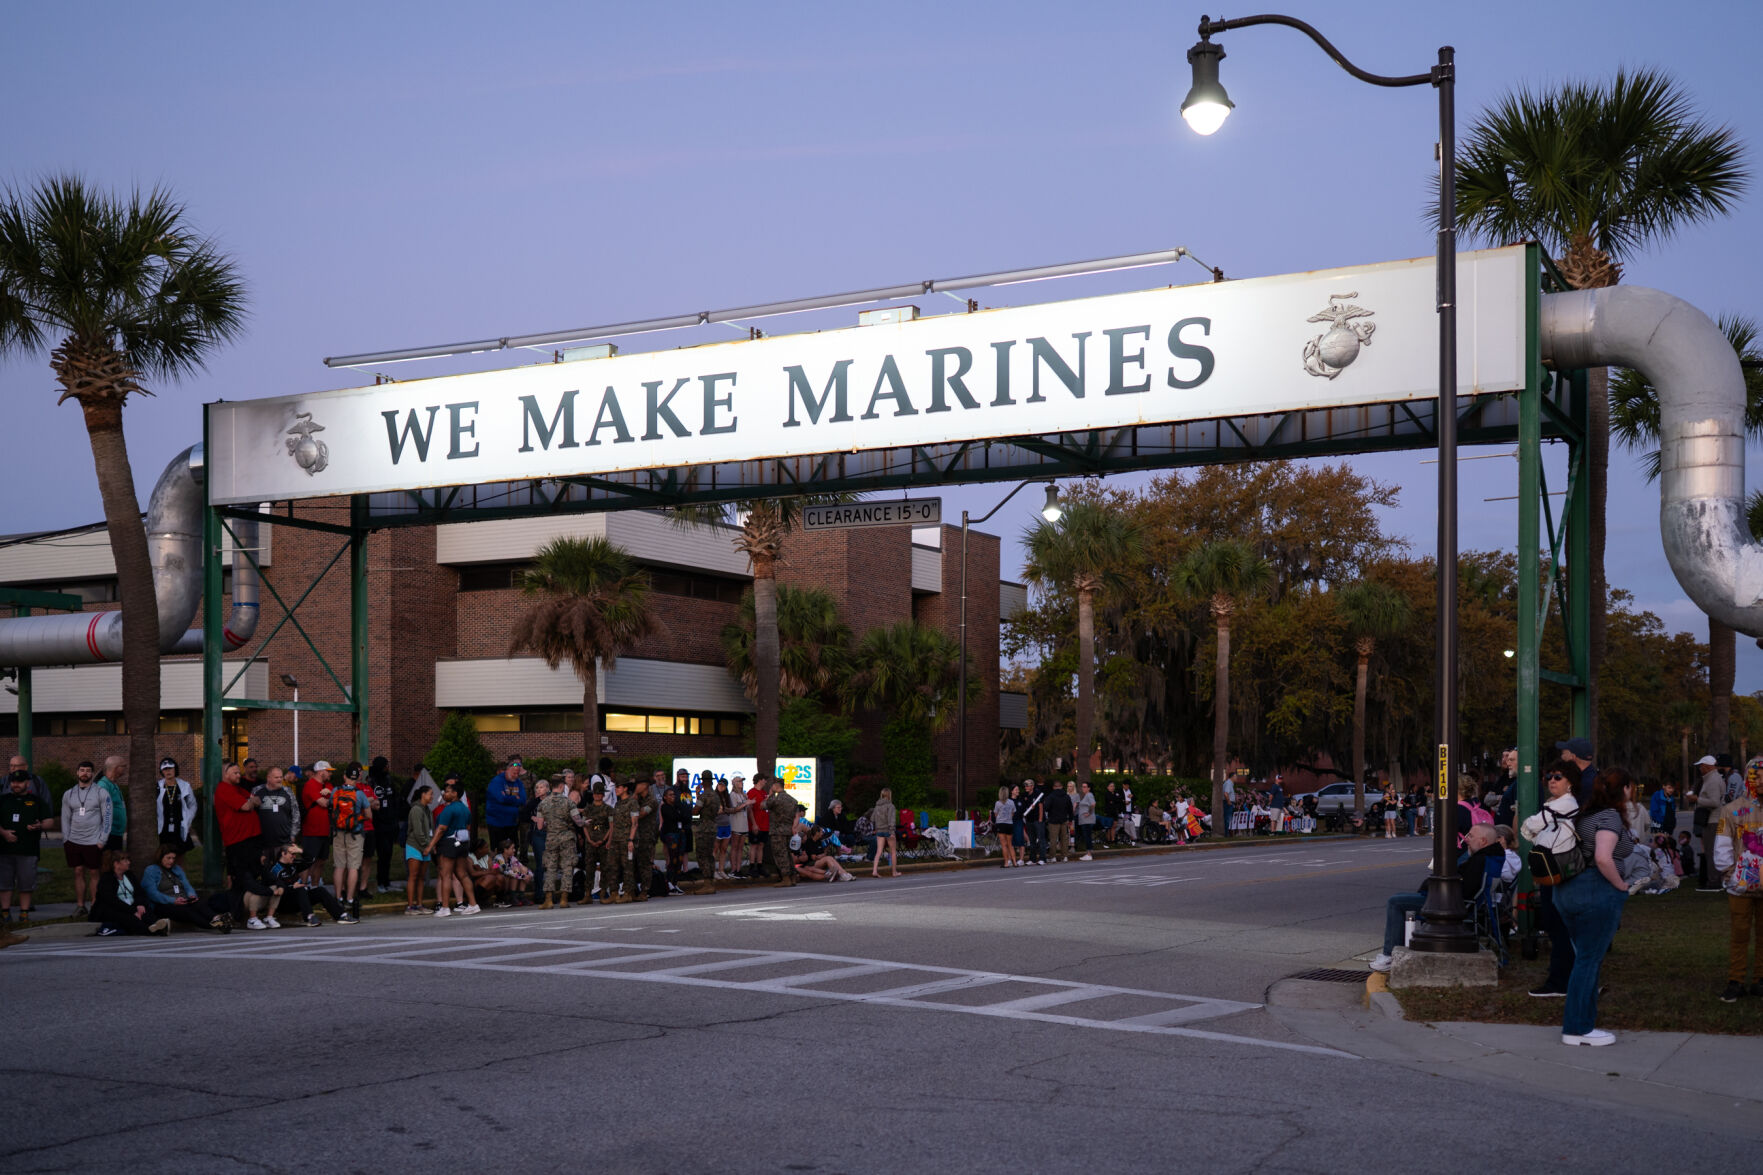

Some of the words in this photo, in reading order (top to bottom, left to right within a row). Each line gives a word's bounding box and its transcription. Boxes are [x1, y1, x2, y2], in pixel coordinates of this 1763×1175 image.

[381, 401, 479, 465] WE
[518, 372, 737, 452] MAKE
[782, 316, 1215, 427] MARINES
[807, 507, 892, 526] CLEARANCE
[897, 503, 937, 520] 15'-0"
